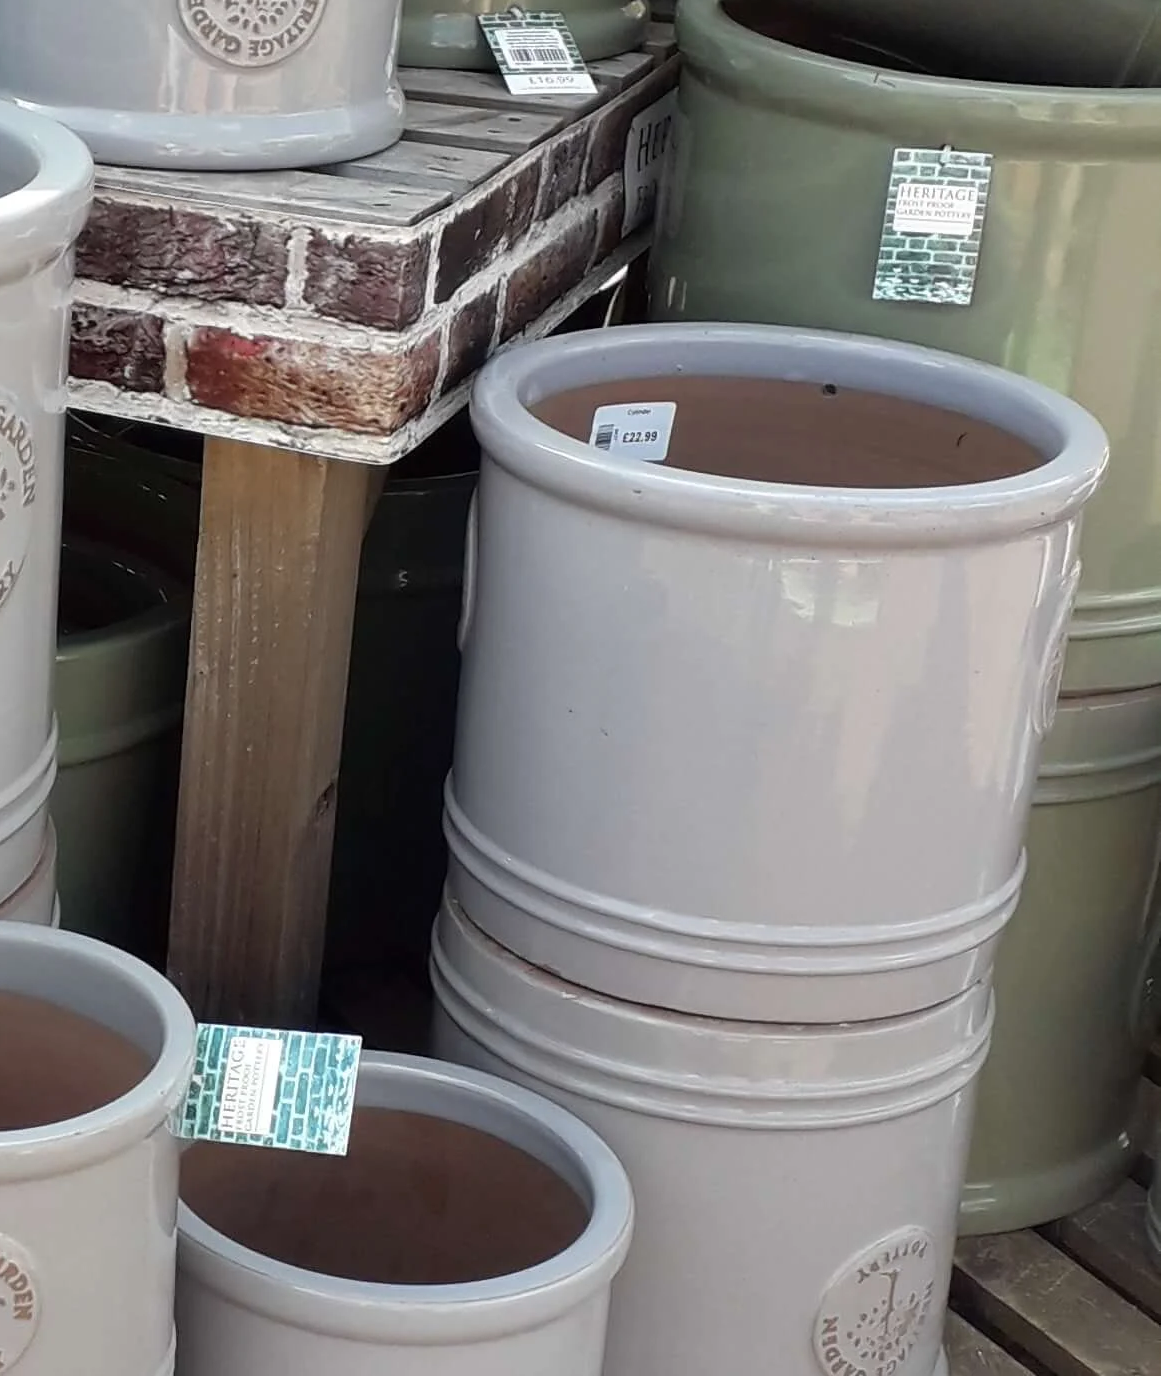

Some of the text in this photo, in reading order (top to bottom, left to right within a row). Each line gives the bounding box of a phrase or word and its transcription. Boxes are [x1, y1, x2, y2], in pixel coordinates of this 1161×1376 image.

[899, 185, 976, 201] HERITAGE
[898, 199, 955, 209] FROST PROOF
[896, 208, 972, 219] GARDEN POTTERY
[622, 431, 658, 443] £22.99
[221, 1038, 247, 1129] HERITAGE
